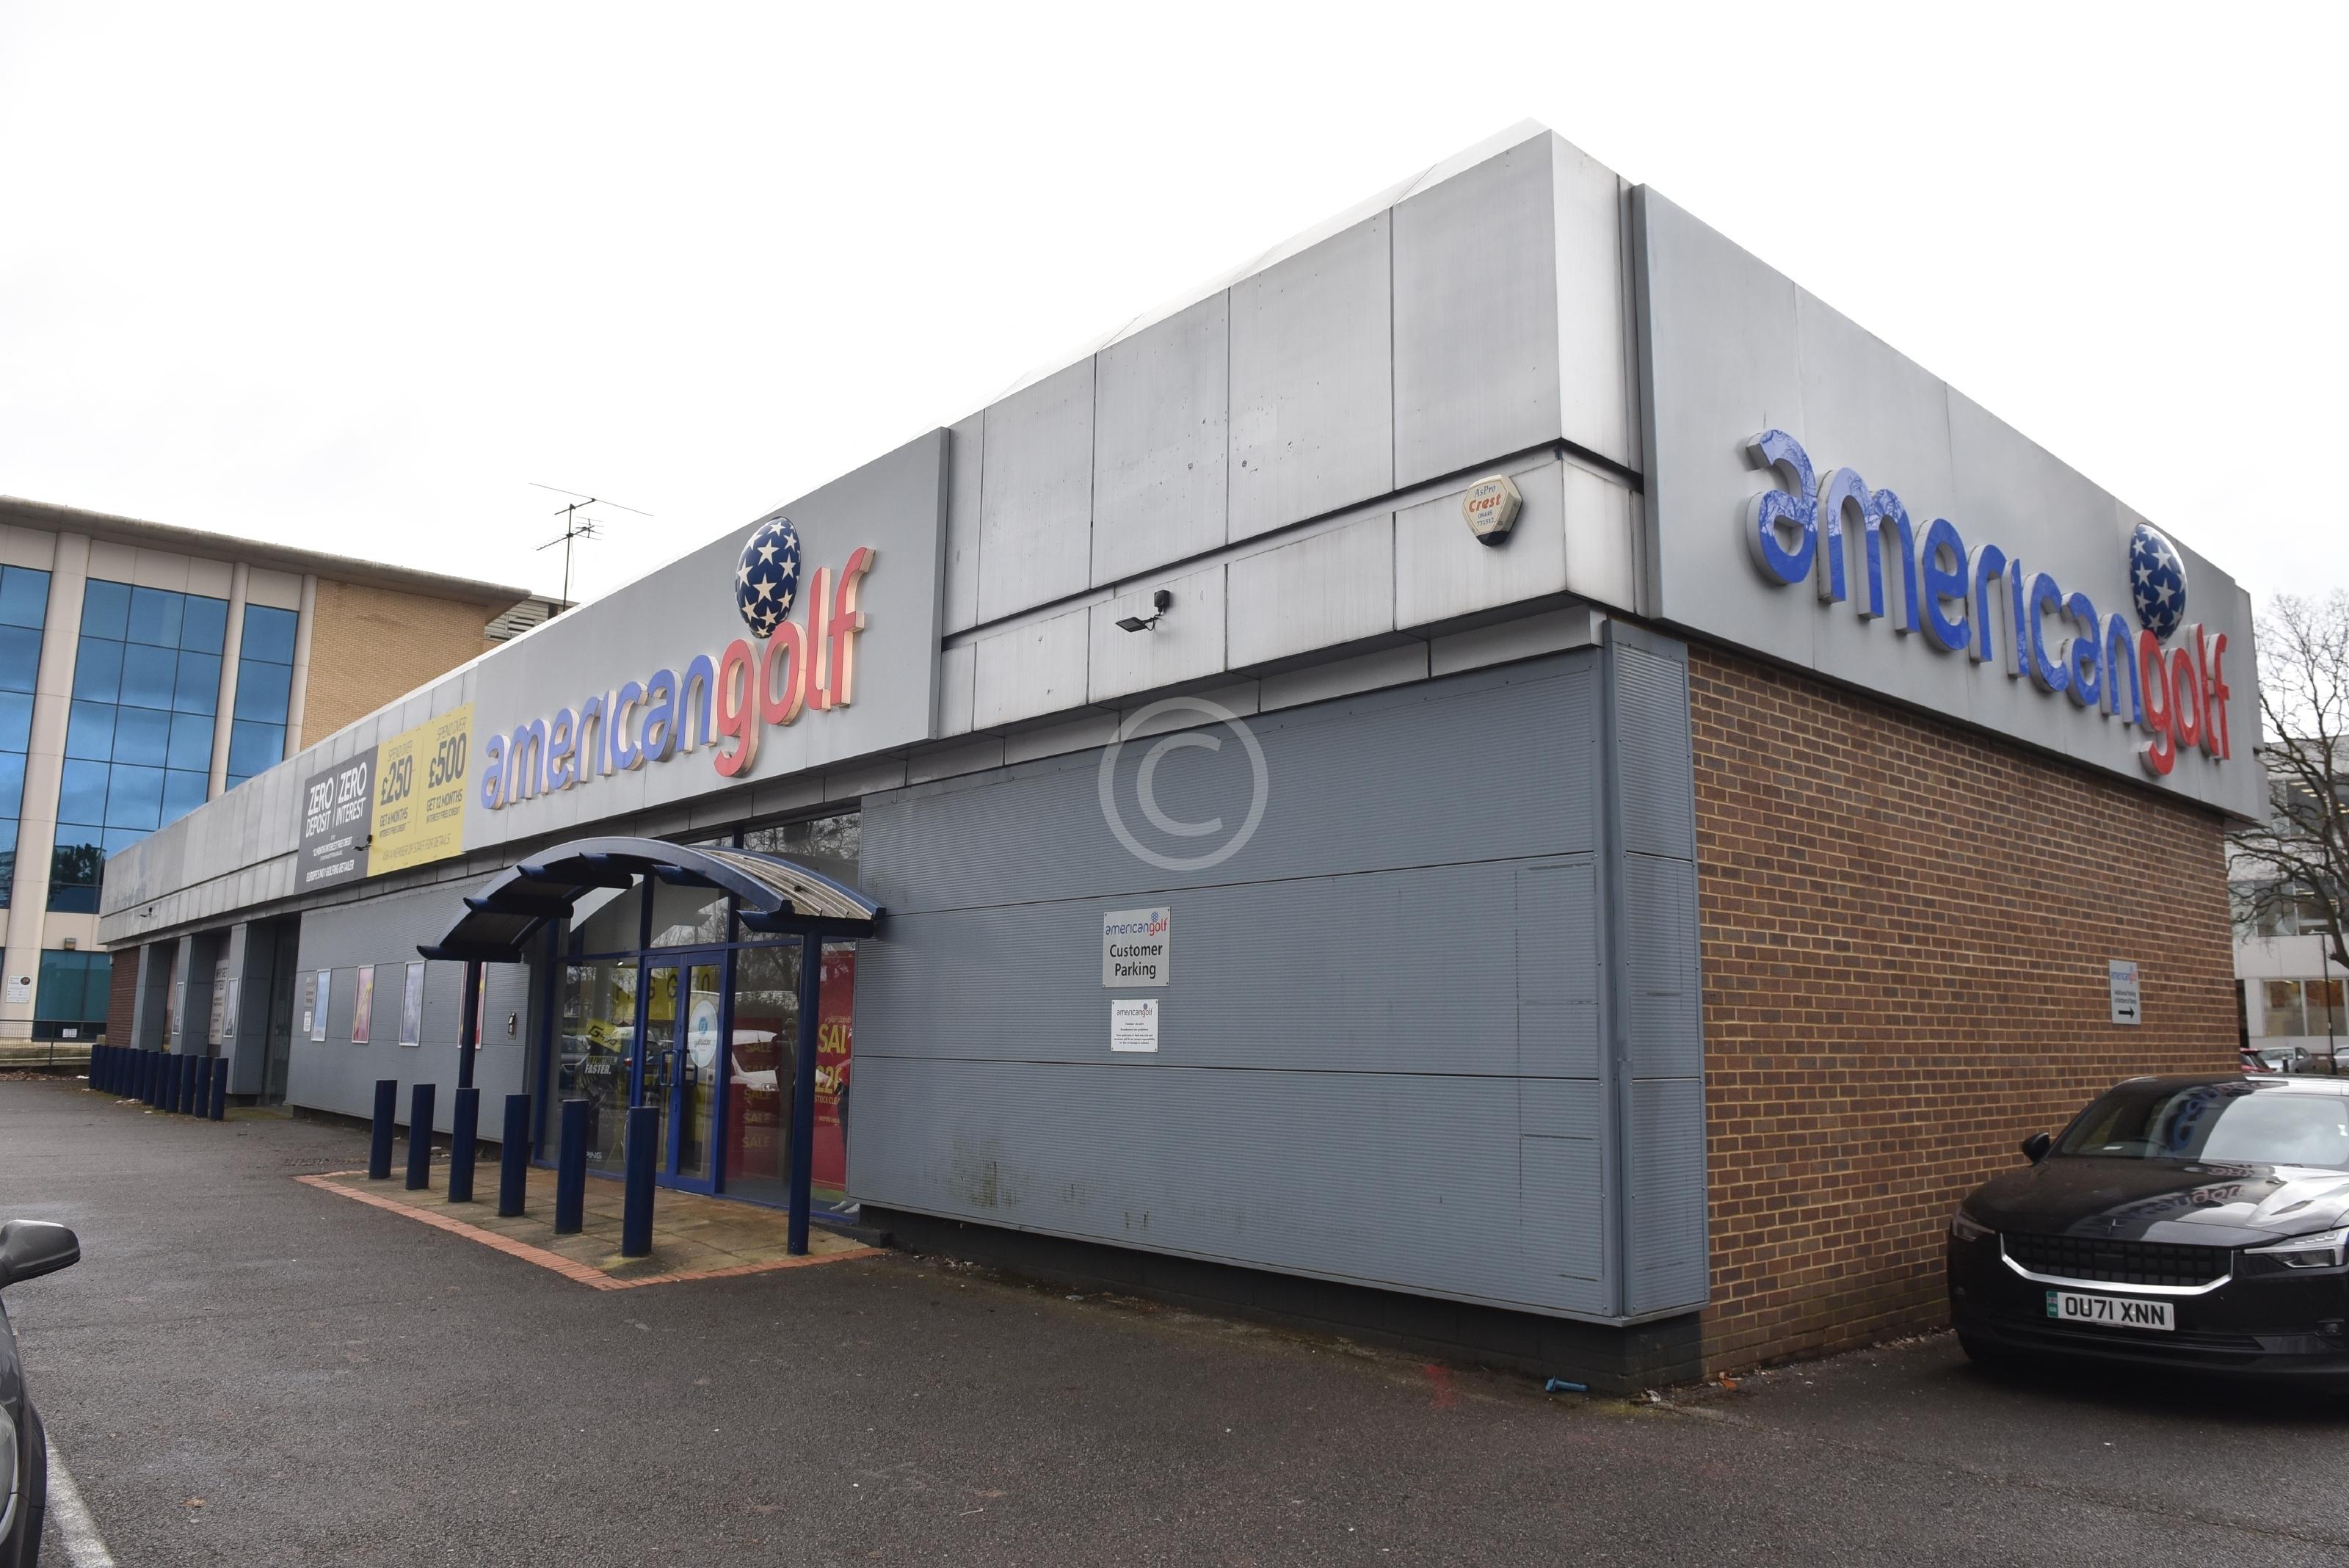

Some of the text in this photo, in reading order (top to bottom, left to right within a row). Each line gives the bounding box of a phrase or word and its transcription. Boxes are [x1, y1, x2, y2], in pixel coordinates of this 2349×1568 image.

[1468, 493, 1502, 512] Crest
[1746, 429, 2230, 776] americangolf
[481, 546, 876, 810] americangolf
[428, 732, 467, 788] £500
[308, 762, 367, 816] ZERO ZERO
[380, 754, 413, 806] £250
[426, 797, 437, 812] GET
[442, 788, 463, 807] MONTHS
[305, 796, 366, 838] DEPOSIT INTEREST
[1105, 918, 1168, 937] americangolf
[1109, 944, 1163, 958] Customer
[1114, 961, 1156, 979] Parking
[1117, 1006, 1153, 1018] americangolf
[818, 1023, 846, 1053] SAL
[584, 1064, 611, 1075] FASTER.
[2065, 1296, 2165, 1326] OU71 XNN
